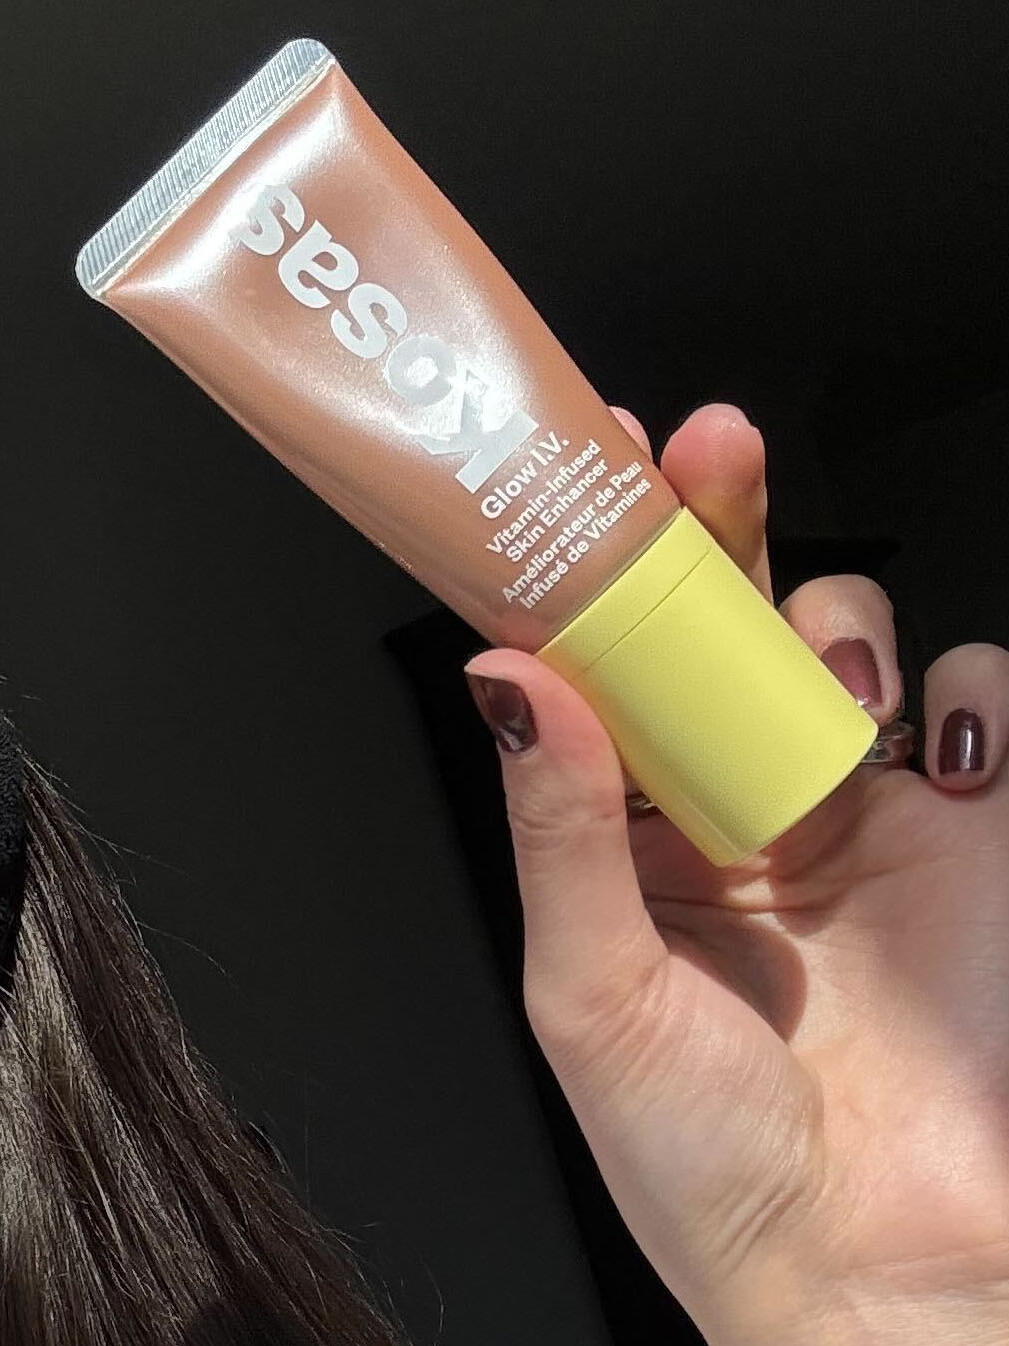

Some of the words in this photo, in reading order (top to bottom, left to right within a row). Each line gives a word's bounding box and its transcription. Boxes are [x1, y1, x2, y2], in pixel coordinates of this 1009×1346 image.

[228, 184, 539, 494] Kosas
[480, 459, 538, 519] Glow
[530, 431, 570, 467] I.V.
[486, 438, 602, 554] Vitamin-Infused
[502, 503, 597, 603] Améliorateur
[594, 487, 616, 508] de
[609, 461, 643, 490] Peau
[506, 524, 545, 563] Skin
[540, 459, 608, 527] Enhancer
[519, 560, 569, 609] Infusé
[566, 540, 590, 563] de
[583, 478, 652, 540] Vitamines
